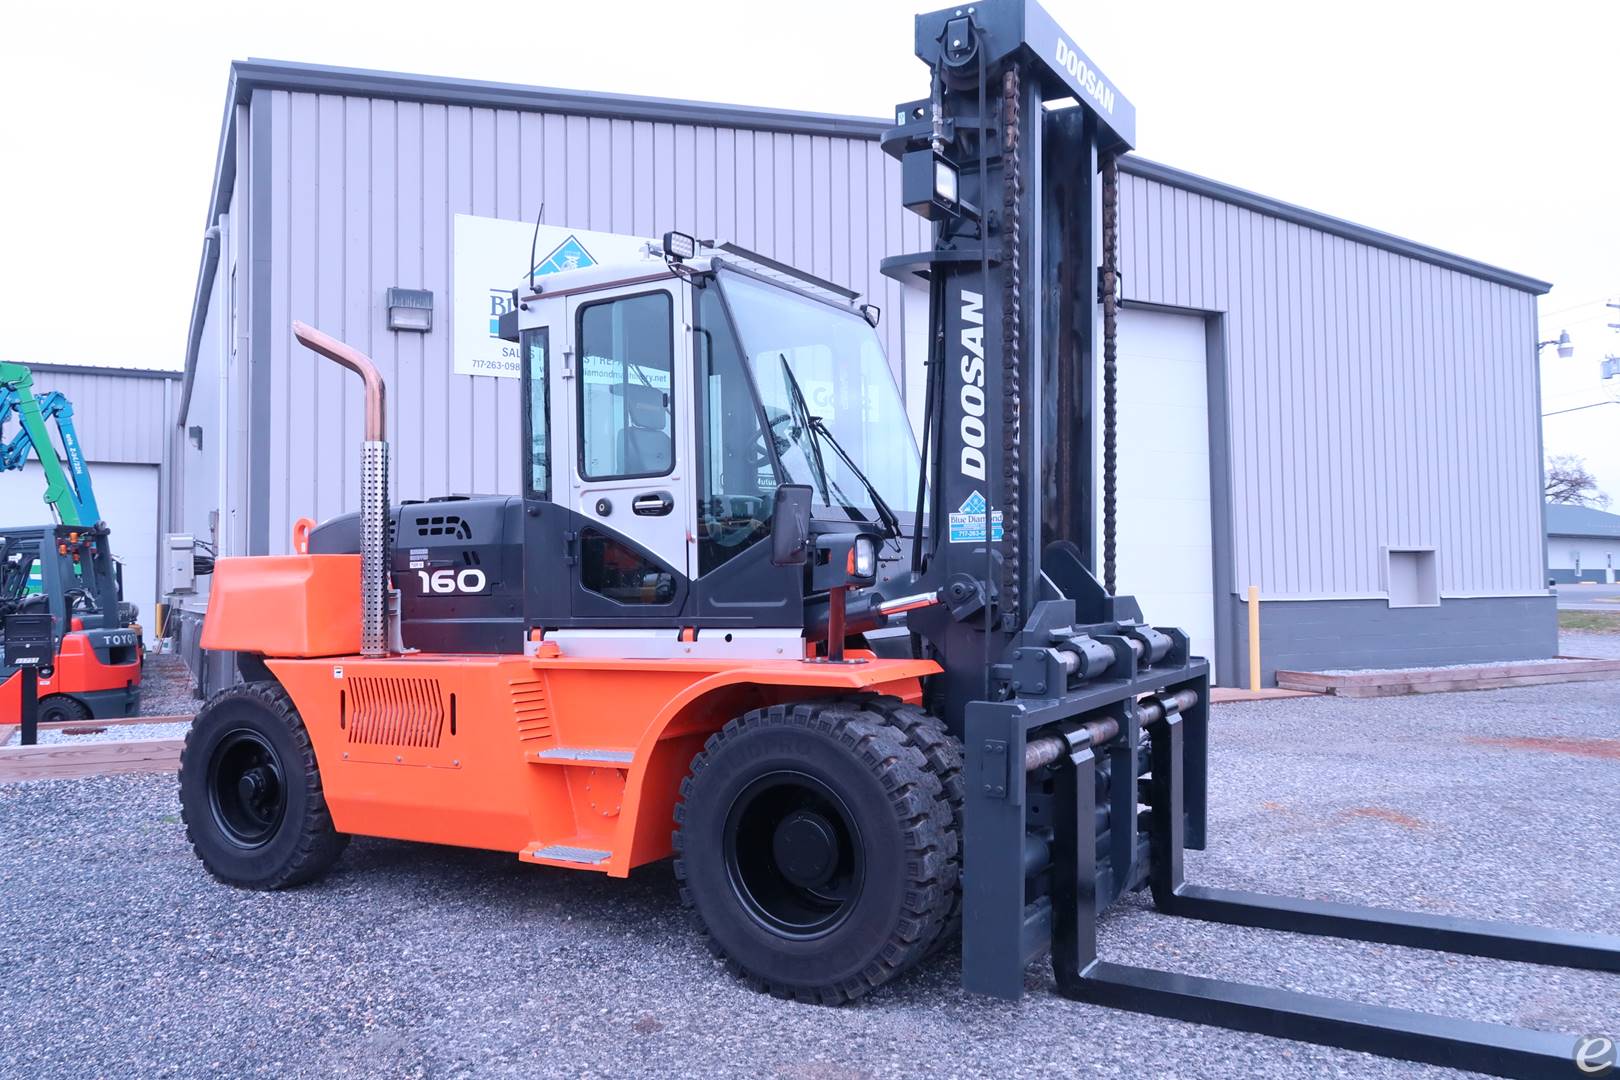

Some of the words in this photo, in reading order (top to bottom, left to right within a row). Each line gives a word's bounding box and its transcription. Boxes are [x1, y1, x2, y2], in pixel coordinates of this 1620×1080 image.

[1055, 37, 1115, 115] DOOSAN
[472, 359, 521, 371] 717-263-098
[961, 289, 986, 481] DOOSAN
[950, 515, 967, 524] Blue
[968, 514, 1003, 523] Diamnd
[418, 568, 486, 594] 160
[104, 633, 136, 646] TOYO
